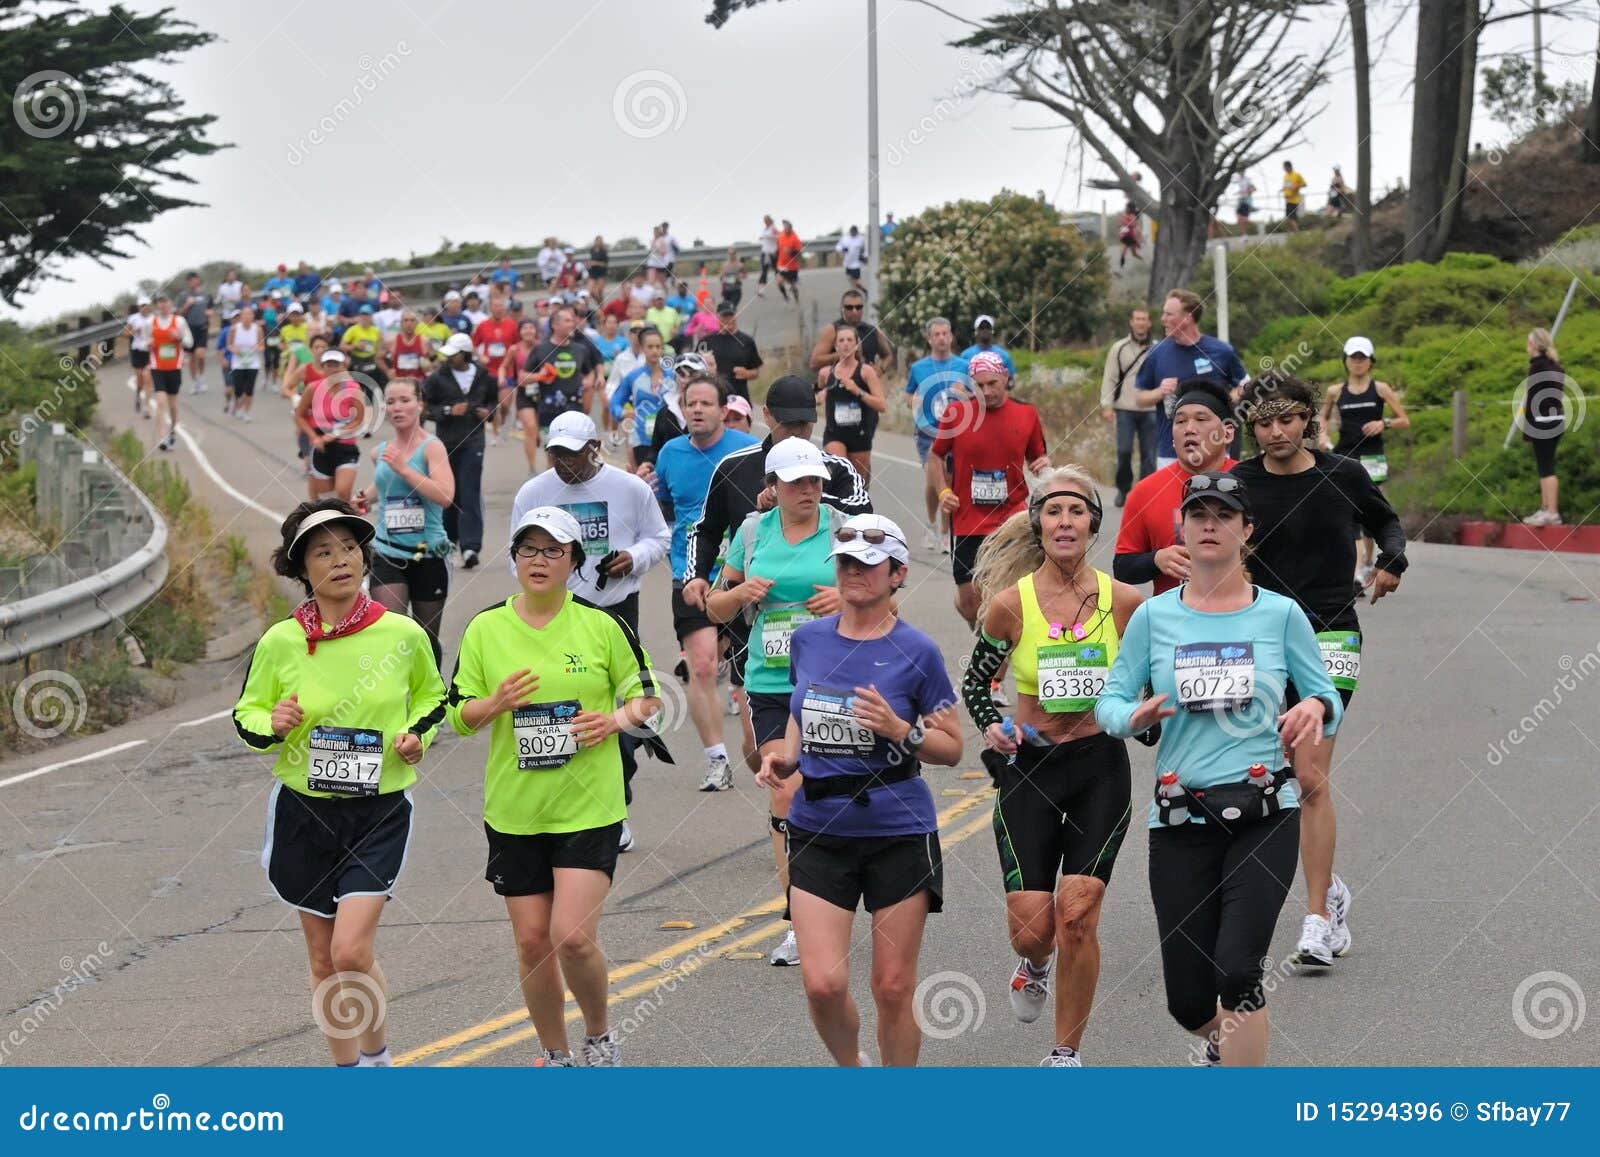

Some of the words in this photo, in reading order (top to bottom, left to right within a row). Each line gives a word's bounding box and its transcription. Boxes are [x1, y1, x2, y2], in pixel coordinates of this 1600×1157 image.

[1038, 657, 1076, 668] MARATHON
[1176, 656, 1217, 668] MARATHON
[1056, 669, 1093, 677] Candace
[1200, 668, 1229, 676] Sandy
[1043, 678, 1105, 698] 63382
[1181, 676, 1249, 698] 60723
[514, 716, 550, 727] MARATHON
[821, 715, 851, 725] Helene
[538, 726, 560, 735] SARA
[806, 722, 871, 743] 40018
[311, 739, 350, 750] MARATHON
[803, 745, 809, 753] 4
[333, 752, 359, 761] Sylvia
[520, 760, 526, 768] 8
[311, 759, 379, 780] 50317
[310, 781, 315, 789] 5
